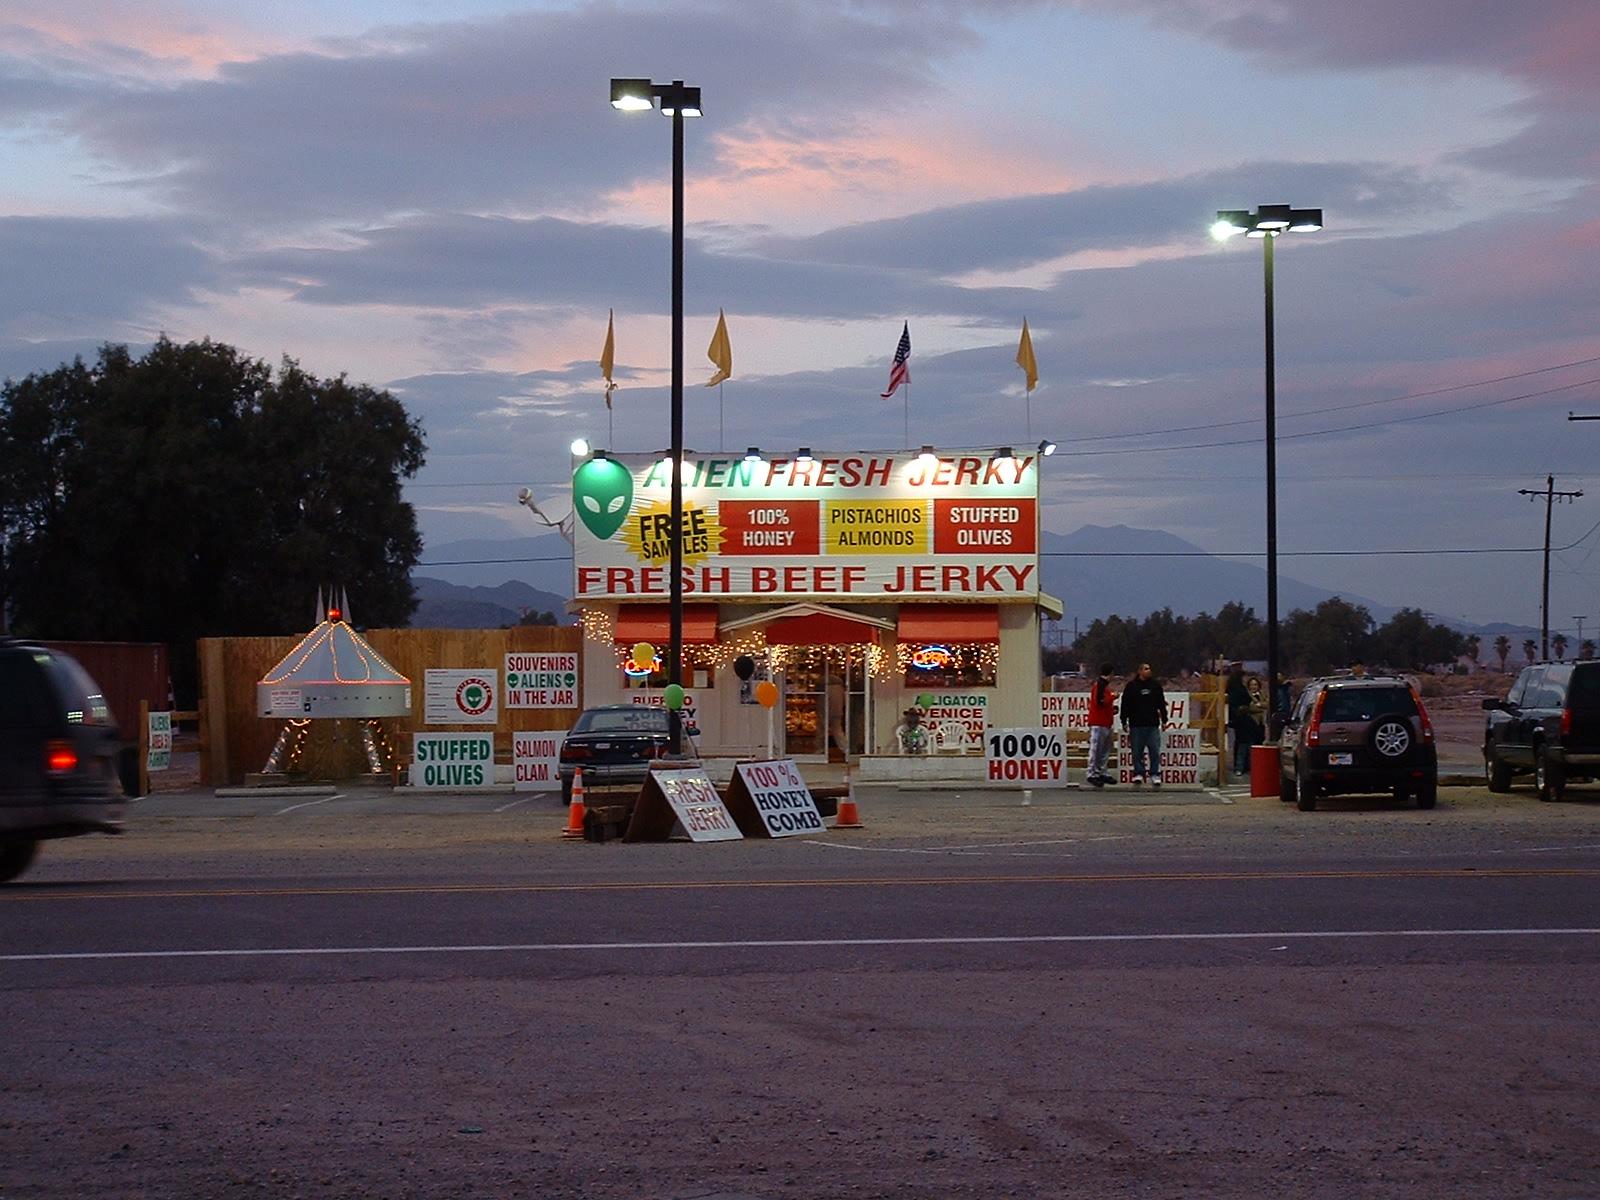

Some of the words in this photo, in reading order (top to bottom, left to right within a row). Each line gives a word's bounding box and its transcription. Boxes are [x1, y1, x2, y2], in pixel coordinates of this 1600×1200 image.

[643, 459, 756, 487] AIEN
[765, 458, 894, 487] FRESH
[909, 456, 1034, 486] JERKY
[747, 508, 790, 526] 100%
[832, 508, 921, 524] PISTACHIOS
[950, 506, 1019, 523] STUFFED
[743, 531, 795, 547] HONEY
[838, 530, 914, 546] ALMONDS
[957, 529, 1012, 545] OLIVES
[643, 536, 708, 559] SAMLES
[578, 567, 730, 594] FRESH
[752, 566, 867, 593] BEEF
[884, 564, 1036, 593] JERKY
[508, 656, 575, 671] SOUVENIRS
[521, 673, 562, 688] ALIENS
[509, 690, 521, 705] IN
[525, 690, 547, 705] THE
[550, 690, 574, 705] JAR
[914, 695, 987, 706] AIGATOR
[1042, 697, 1064, 711] DRY
[918, 720, 984, 731] SAON
[1042, 714, 1065, 728] DRY
[515, 740, 556, 758] SALMON
[990, 734, 1062, 757] 100%
[1166, 734, 1196, 749] JERKY
[417, 740, 490, 761] STUFFED
[1160, 752, 1198, 767] GLAZED
[424, 764, 484, 786] OLIVES
[516, 764, 549, 782] CLAM
[989, 760, 1062, 780] HONEY
[755, 789, 811, 811] HONEY
[767, 810, 821, 833] COMB
